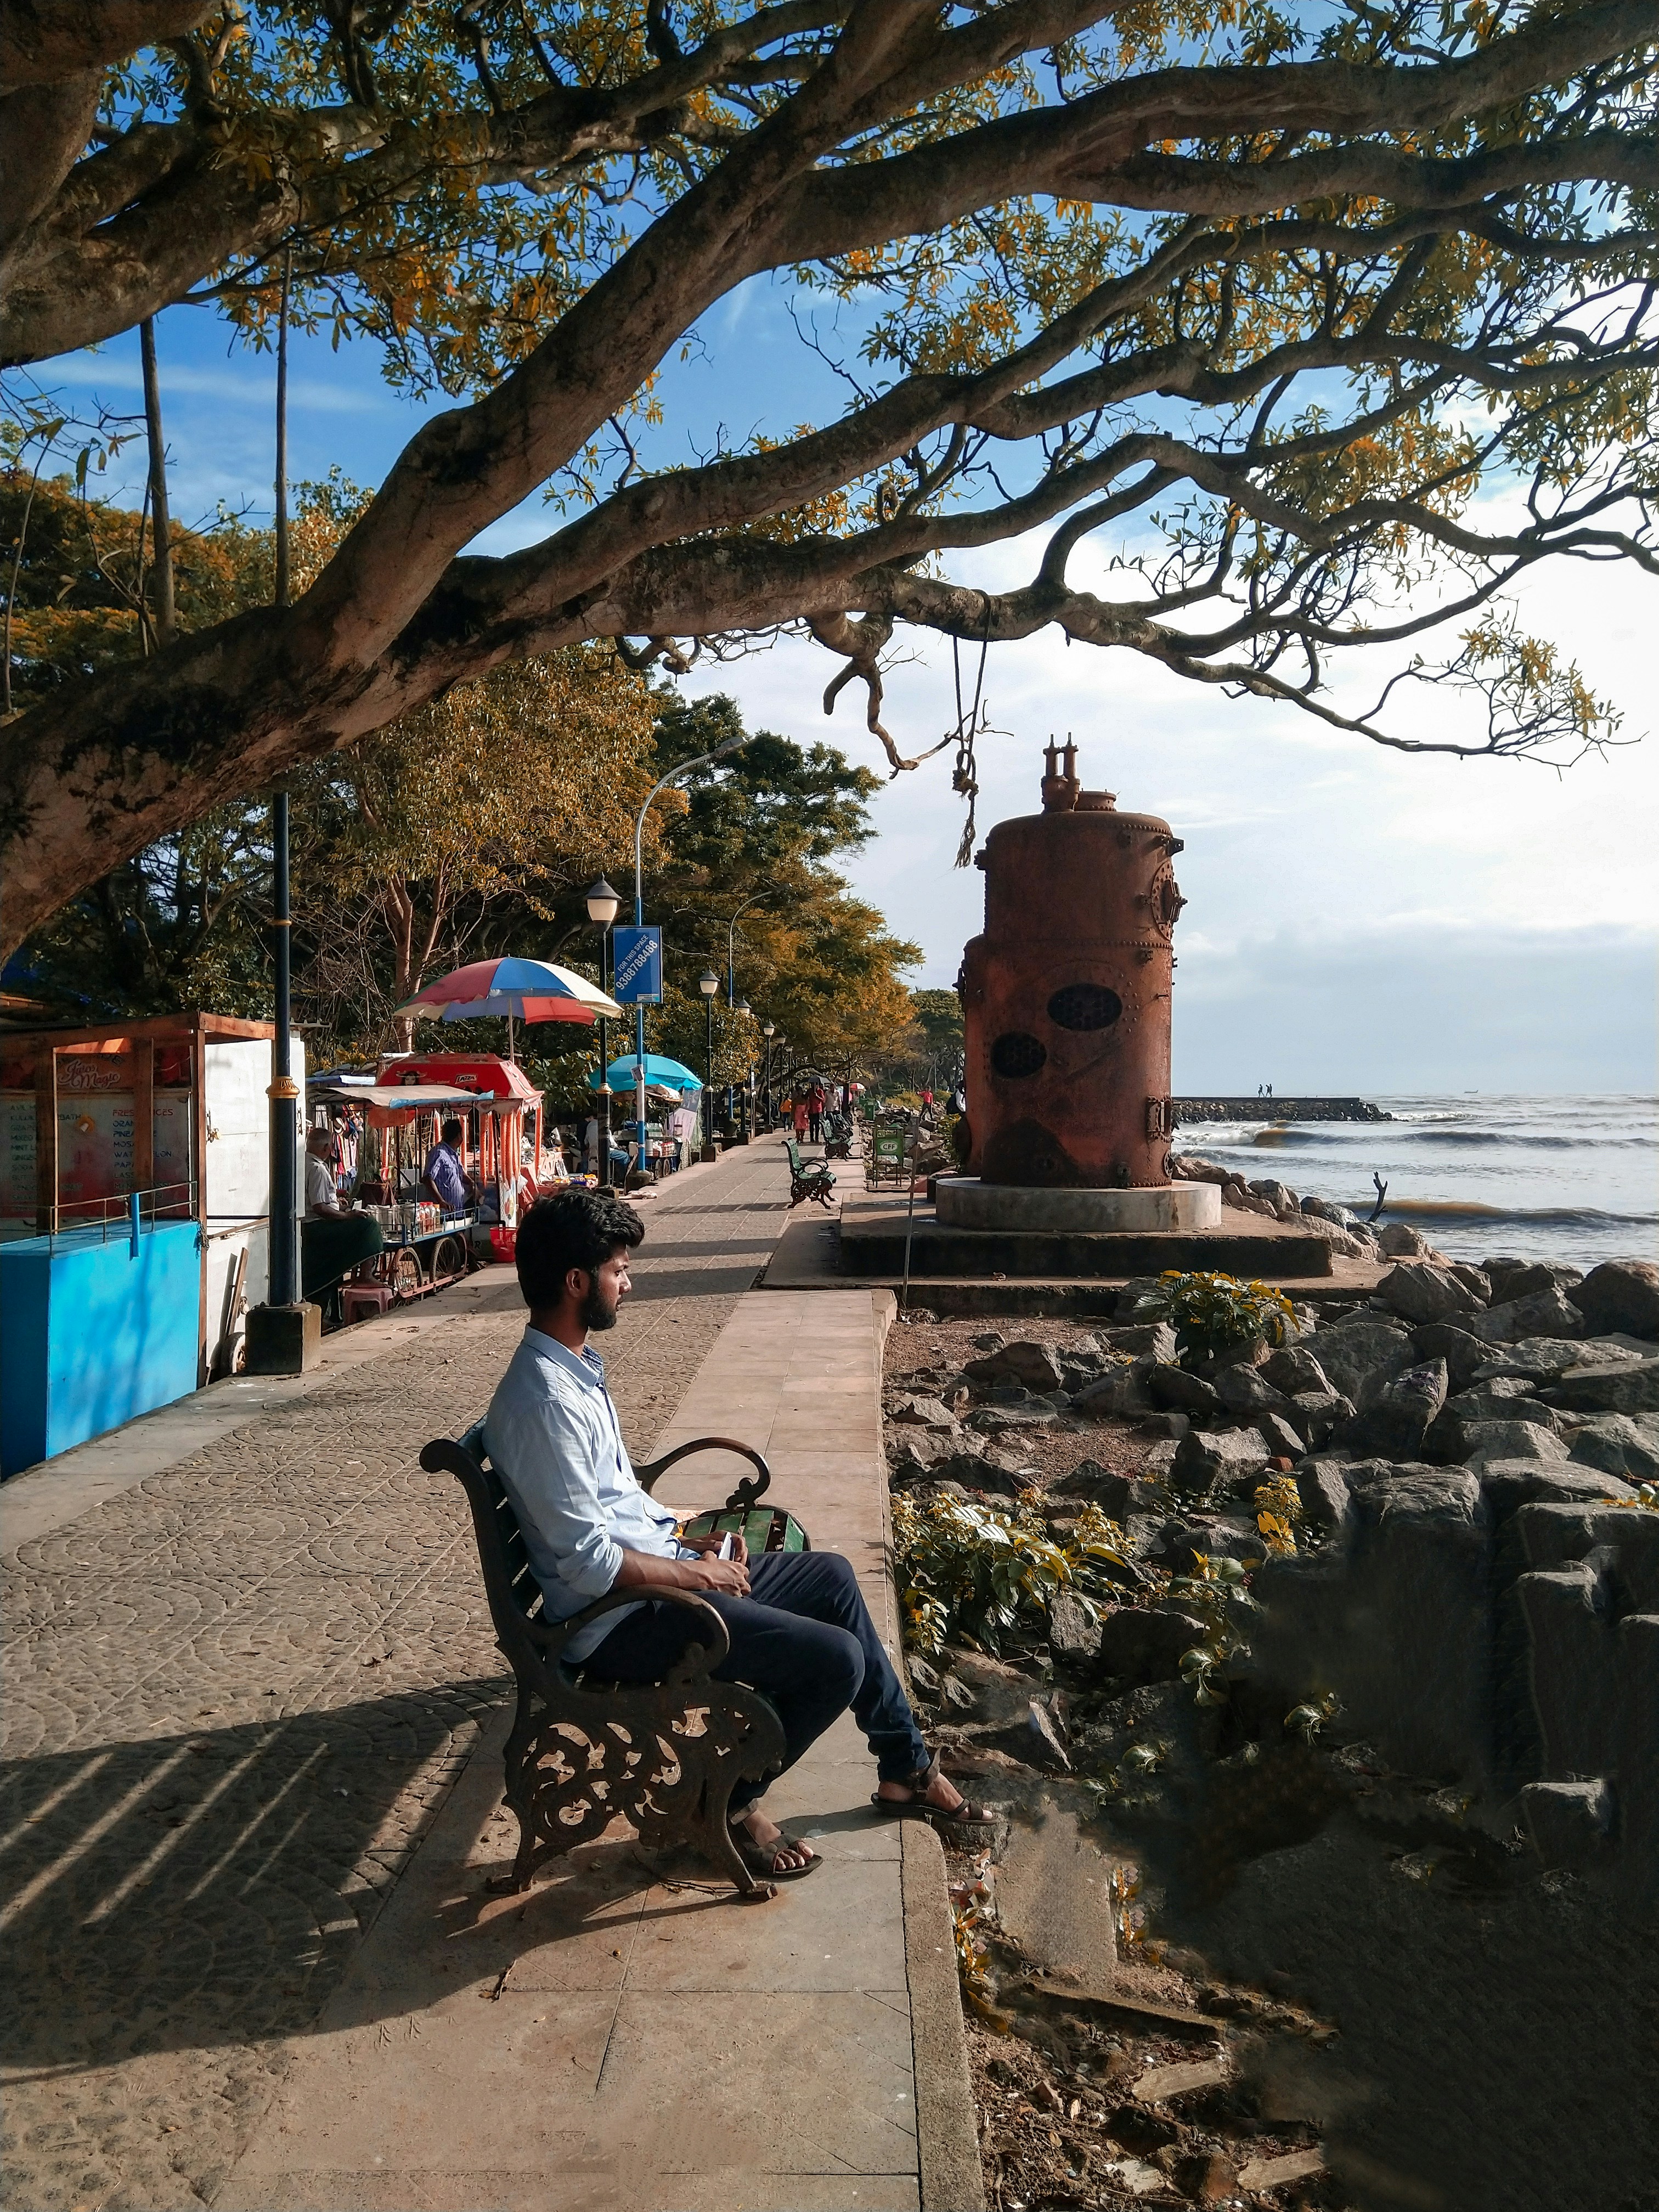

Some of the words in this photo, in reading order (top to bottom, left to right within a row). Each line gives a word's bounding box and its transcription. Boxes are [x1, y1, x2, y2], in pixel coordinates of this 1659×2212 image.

[616, 940, 658, 990] 9388788488
[617, 961, 628, 972] FOR
[624, 949, 636, 962] THIS
[634, 934, 648, 951] SPACE
